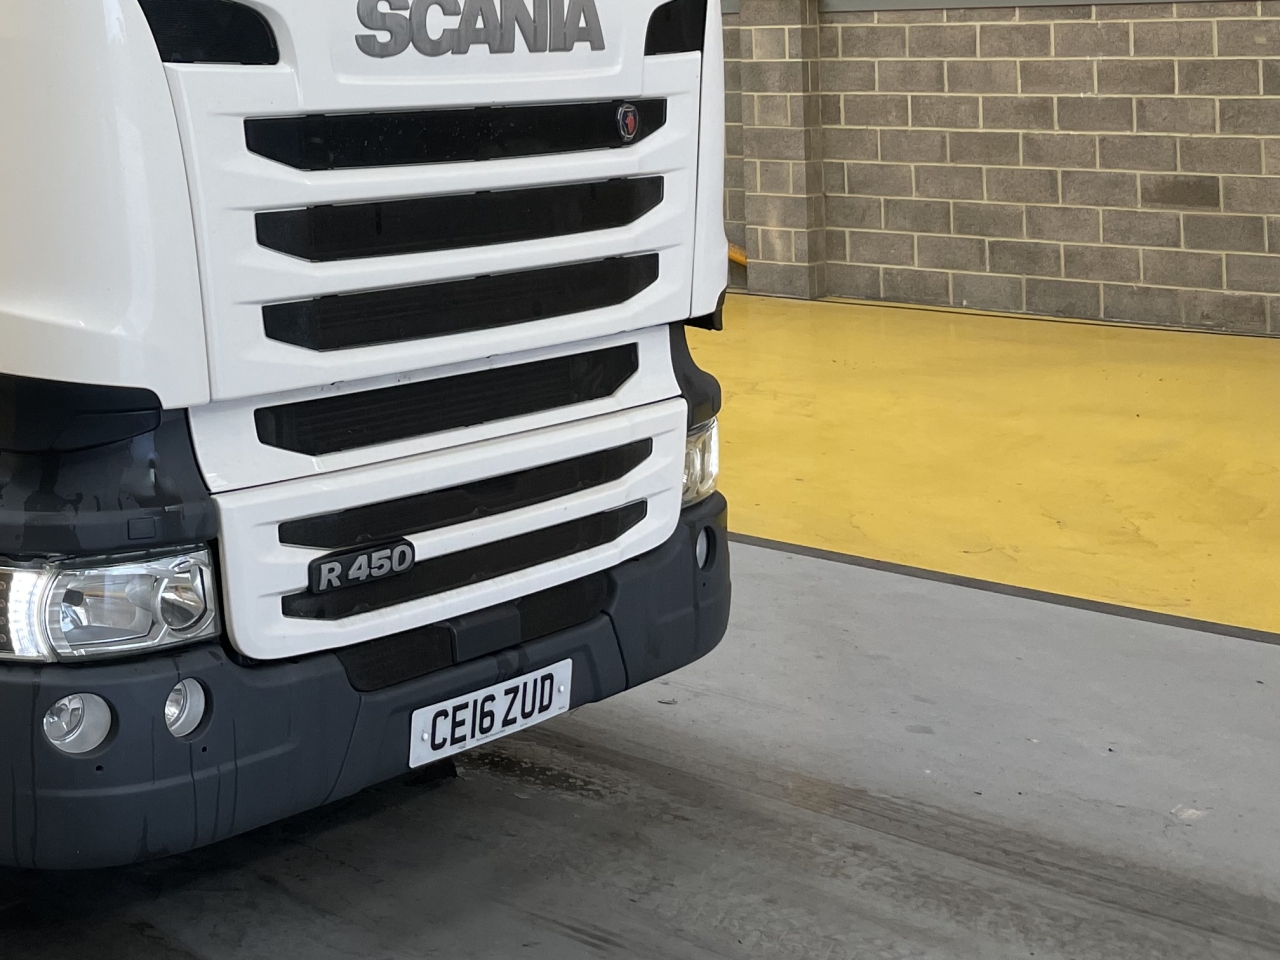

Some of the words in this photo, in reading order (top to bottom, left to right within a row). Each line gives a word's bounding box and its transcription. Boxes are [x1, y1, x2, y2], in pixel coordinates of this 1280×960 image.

[319, 561, 342, 591] R
[348, 544, 412, 581] 450
[430, 693, 496, 751] CE16
[501, 672, 554, 728] ZUD
